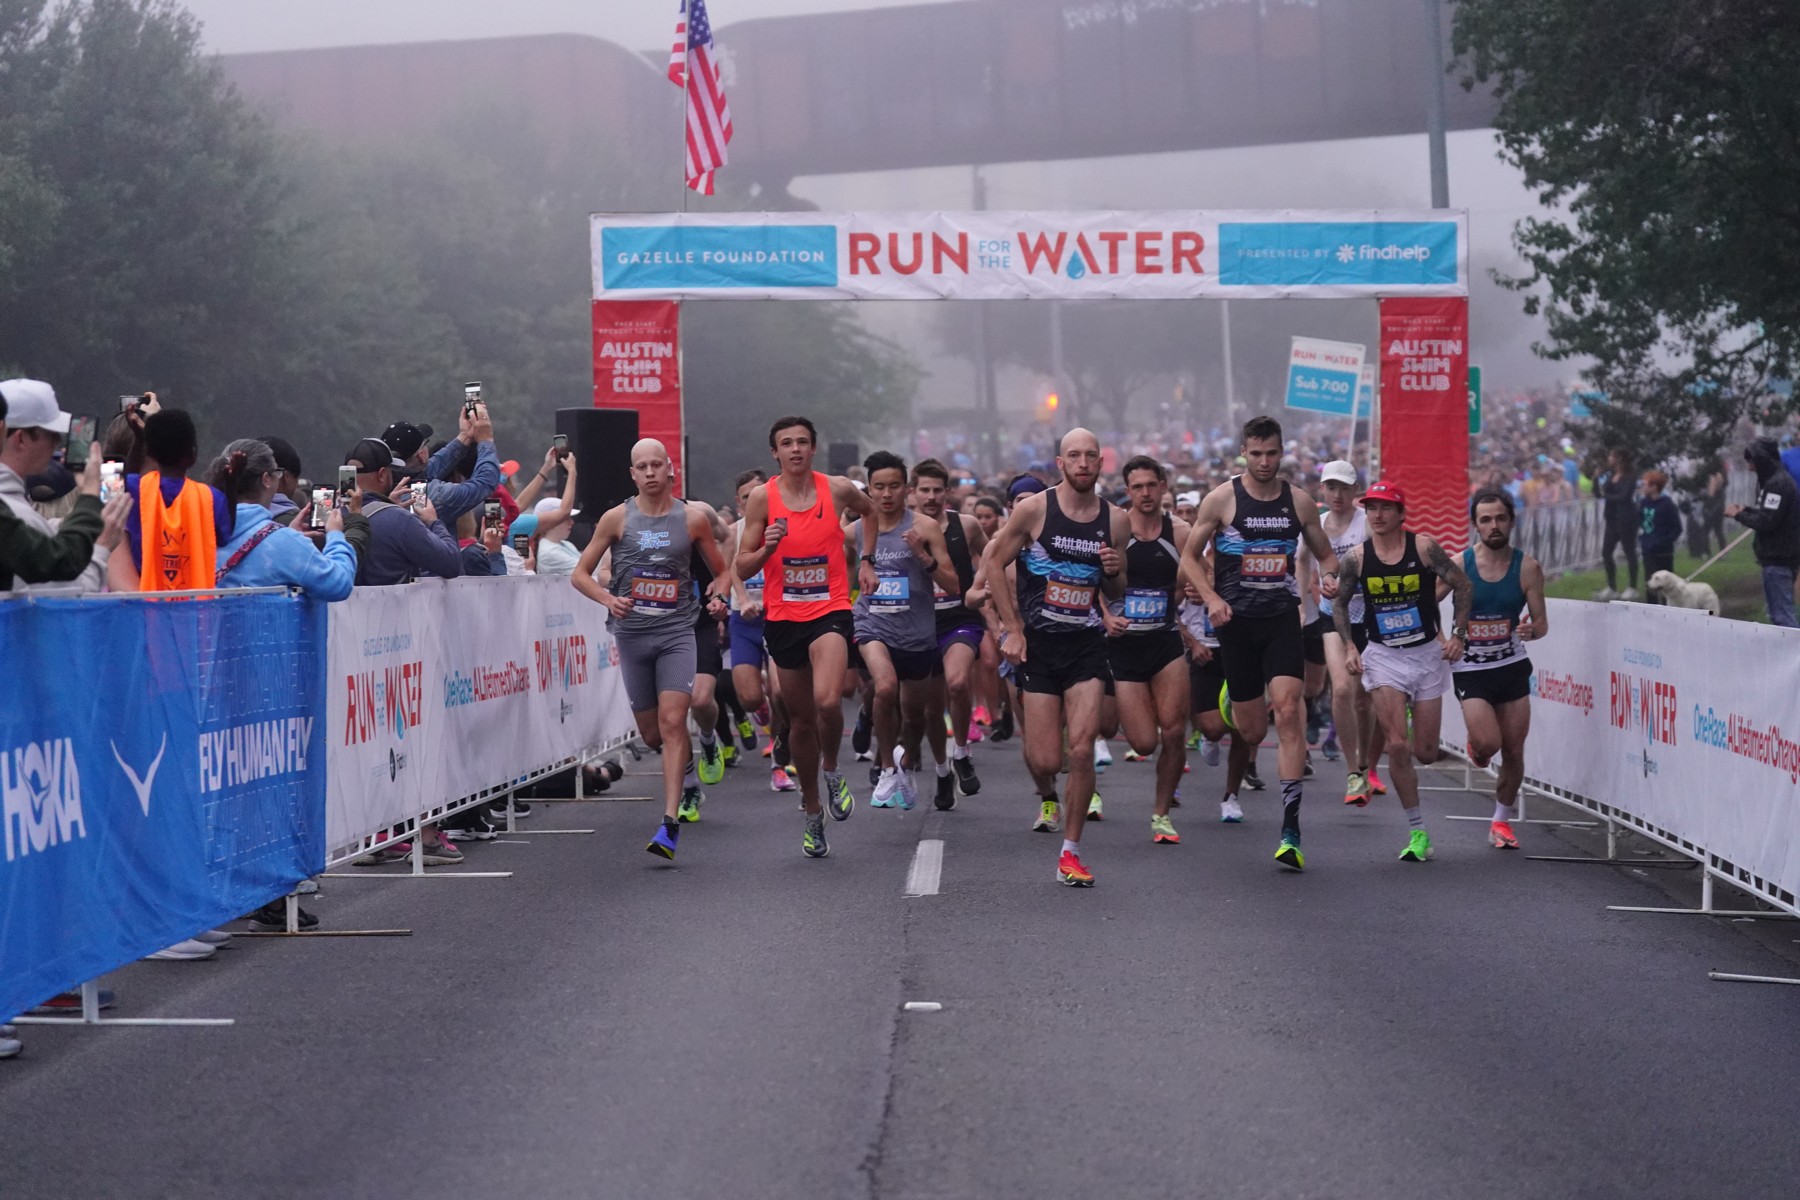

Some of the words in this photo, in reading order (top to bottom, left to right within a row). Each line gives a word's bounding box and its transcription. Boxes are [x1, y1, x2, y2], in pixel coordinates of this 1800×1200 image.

[849, 231, 969, 275] RUN
[979, 239, 1011, 253] FOR
[1017, 231, 1205, 276] WATER
[1238, 249, 1310, 259] PRESENTED
[1315, 249, 1330, 258] BY
[1359, 244, 1431, 262] findhelp
[617, 251, 695, 265] GAZELLE
[703, 250, 825, 264] FOUNDATION
[979, 255, 1011, 269] THE
[600, 342, 673, 358] AUSTIN
[1293, 349, 1317, 360] RUN
[1388, 339, 1463, 356] AUSTIN
[612, 359, 662, 375] SWIM
[1324, 353, 1359, 367] WATER
[1401, 357, 1451, 373] SWIM
[613, 376, 662, 393] CLUB
[1295, 374, 1319, 391] Sub
[1401, 374, 1451, 391] CLUB
[1243, 516, 1291, 529] RAILROAD
[1051, 535, 1101, 554] RAILROAD
[1245, 558, 1285, 573] 3307
[785, 568, 826, 585] 3428
[634, 581, 676, 599] 4079
[1048, 585, 1091, 606] 3308
[1128, 600, 1163, 614] 1441
[1384, 612, 1414, 630] 988
[1471, 623, 1508, 638] 3335
[534, 639, 552, 694] RUN
[345, 669, 376, 746] RUN
[1610, 670, 1631, 733] RUN
[1639, 676, 1677, 747] WATER
[199, 729, 225, 794] FLY
[226, 718, 285, 787] HUMAN
[287, 716, 314, 773] FLY
[0, 736, 87, 862] HOKA
